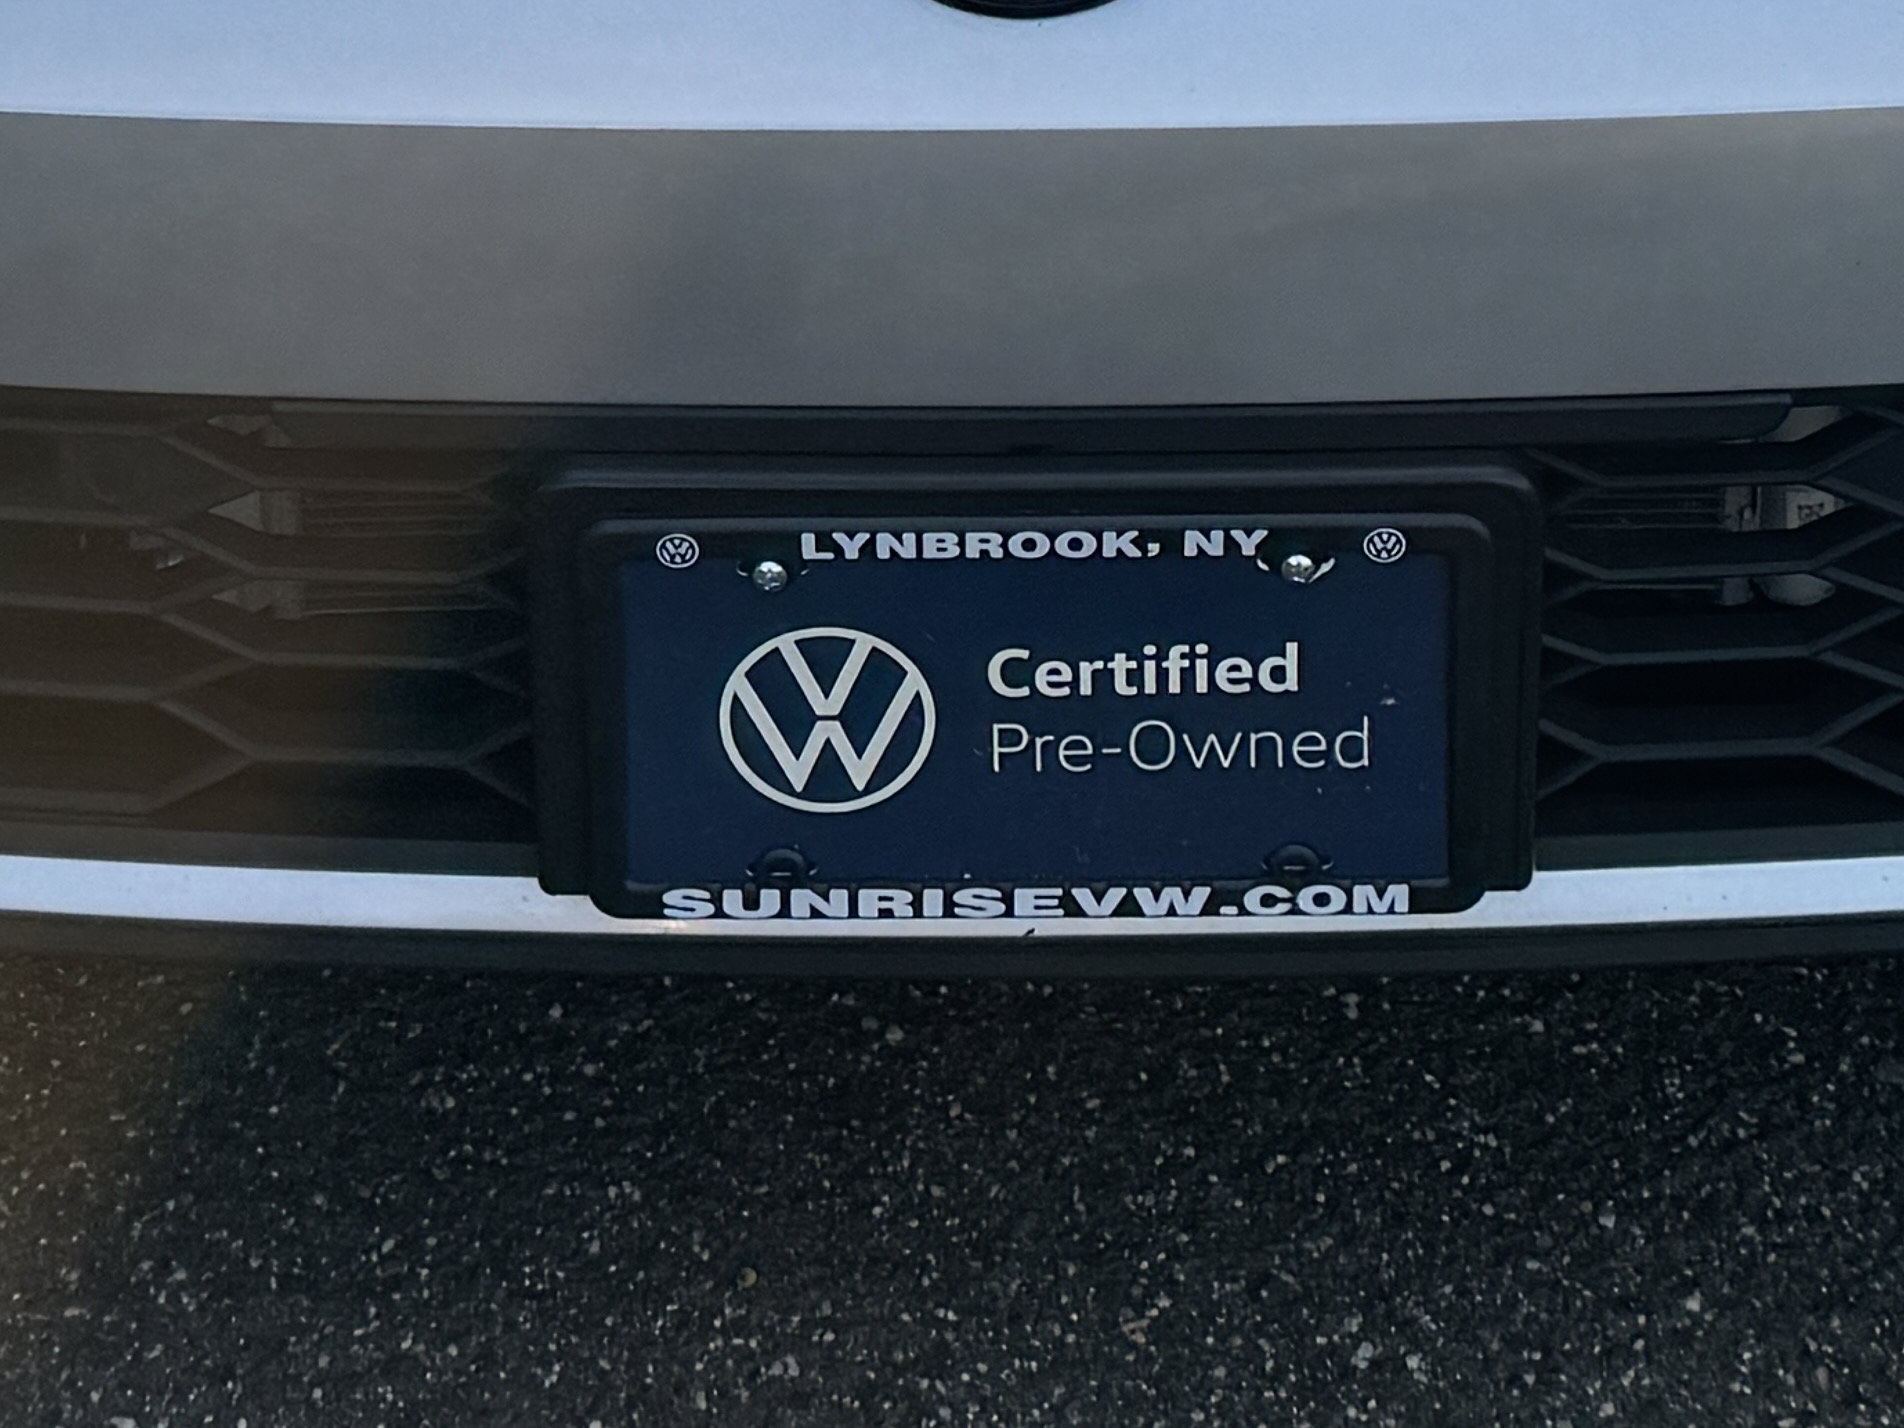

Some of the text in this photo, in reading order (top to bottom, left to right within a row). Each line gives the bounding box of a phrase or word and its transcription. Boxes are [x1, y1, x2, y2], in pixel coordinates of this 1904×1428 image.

[800, 529, 1269, 560] LYNBROOK, NY
[987, 641, 1299, 698] Certified
[991, 715, 1370, 773] Pre-Owned
[662, 883, 1410, 919] SUNRISEVW.COM
